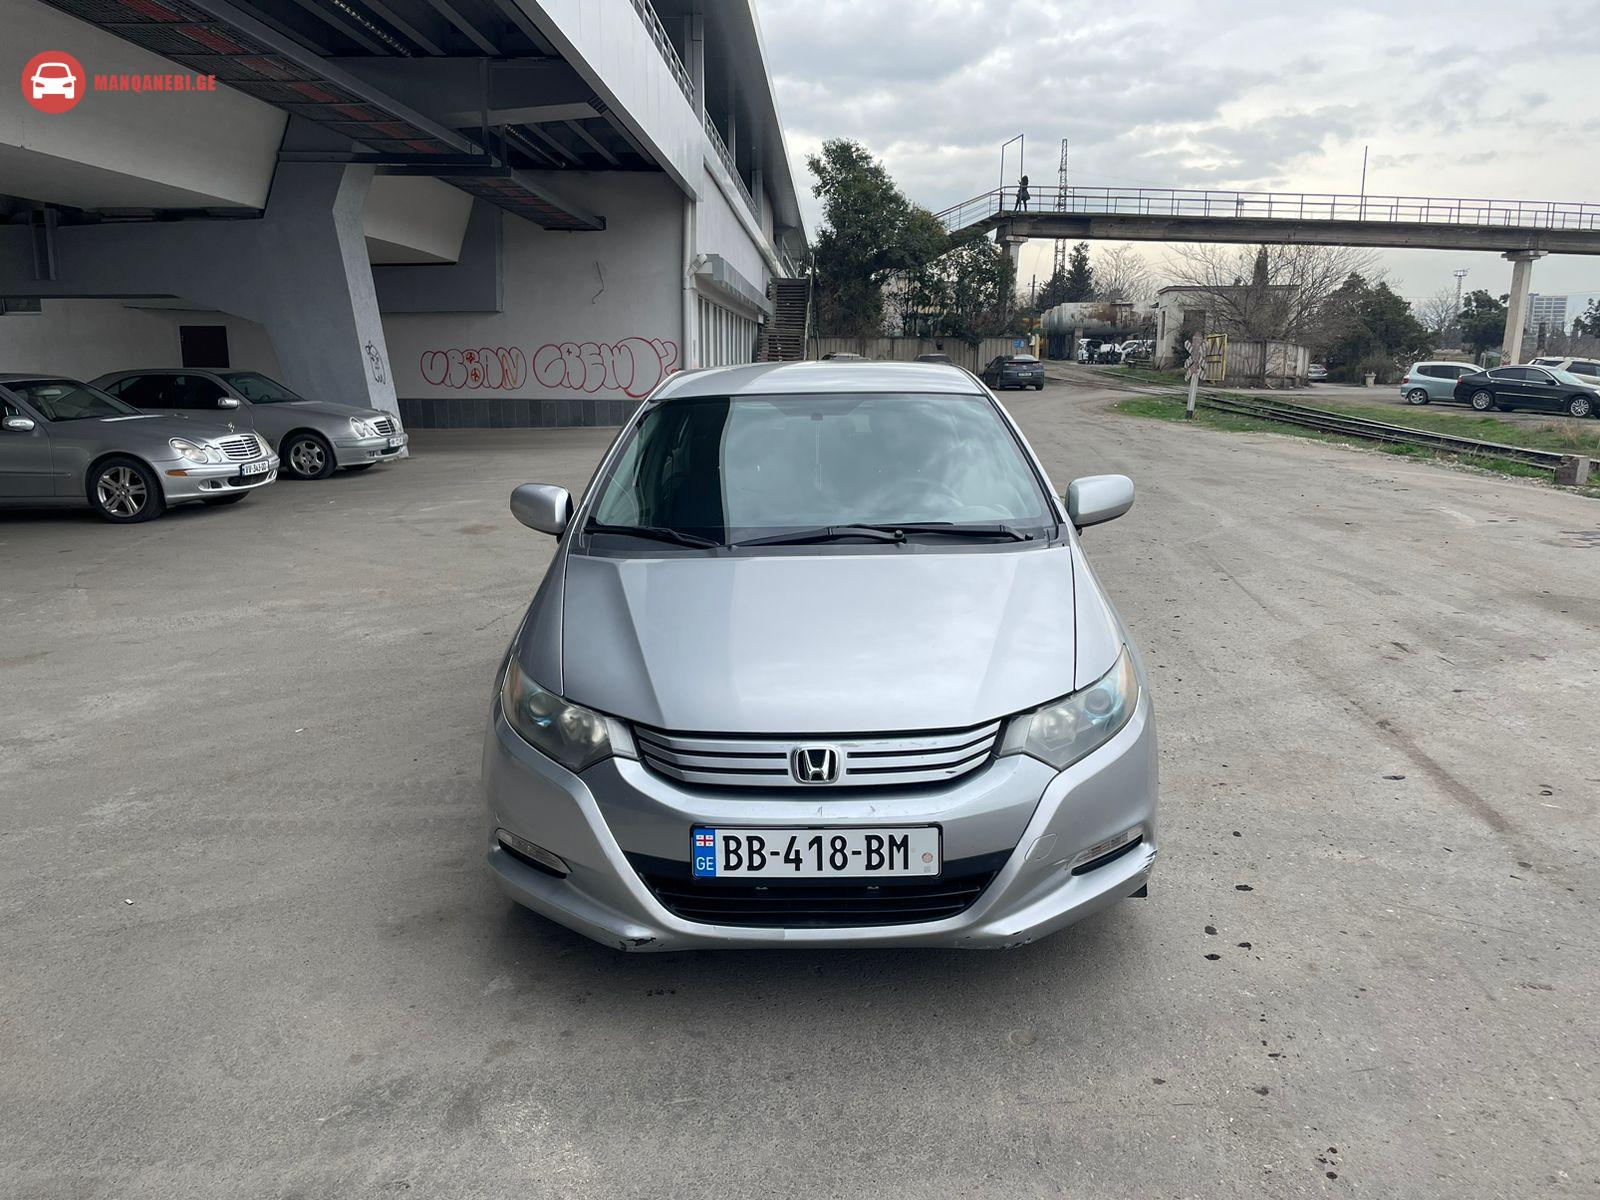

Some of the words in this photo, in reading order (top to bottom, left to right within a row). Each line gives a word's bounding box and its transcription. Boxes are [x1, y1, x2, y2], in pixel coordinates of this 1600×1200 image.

[420, 346, 527, 391] URBAN
[696, 856, 714, 871] GE
[722, 834, 909, 871] BB-418-BM
